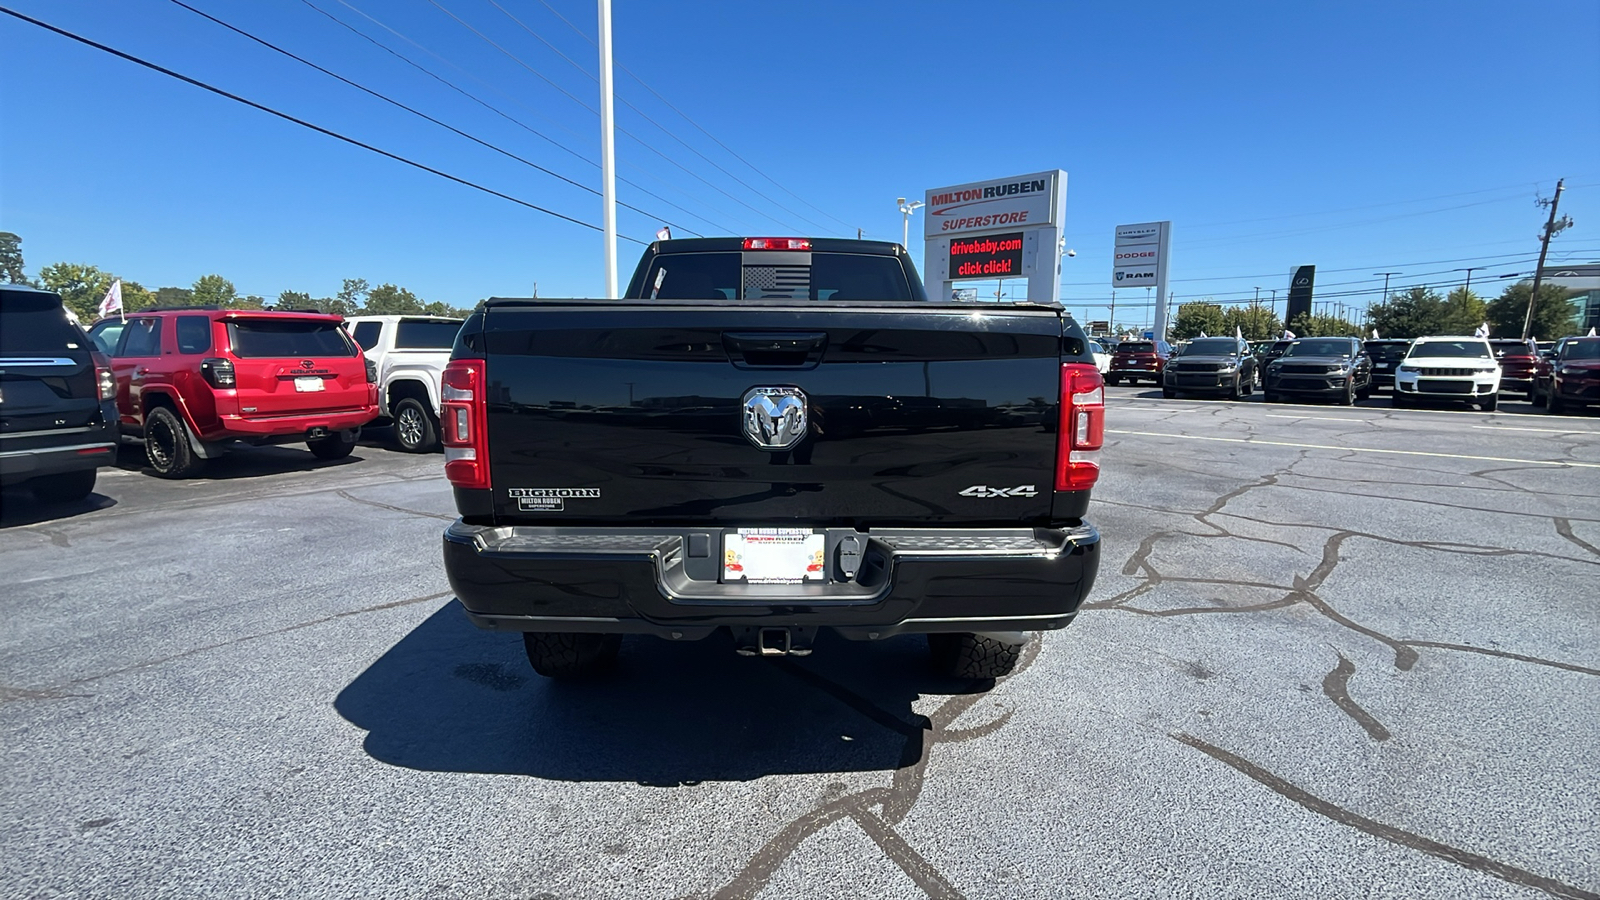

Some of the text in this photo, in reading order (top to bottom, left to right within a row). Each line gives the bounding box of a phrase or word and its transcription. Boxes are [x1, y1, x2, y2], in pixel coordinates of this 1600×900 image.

[941, 211, 1029, 231] SUPERSTORE
[950, 239, 1022, 256] drivebaby.com
[958, 259, 1012, 275] click click!
